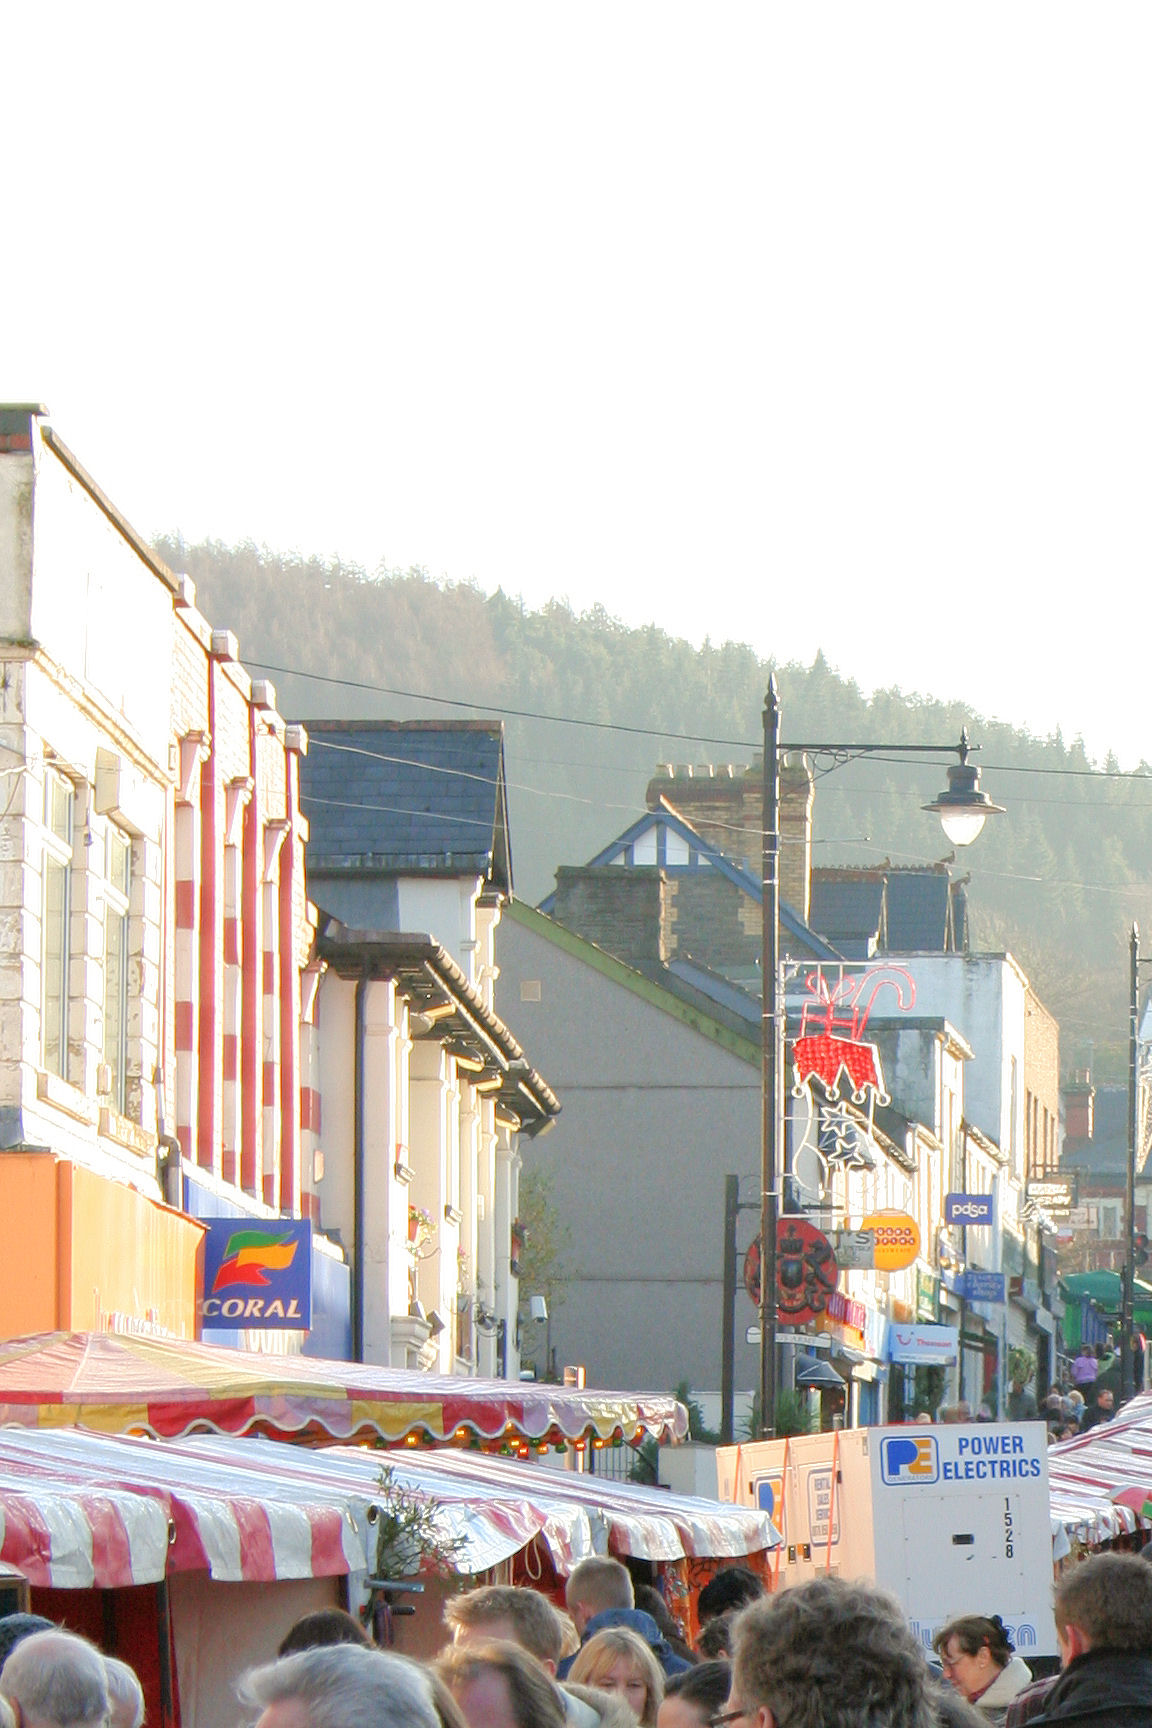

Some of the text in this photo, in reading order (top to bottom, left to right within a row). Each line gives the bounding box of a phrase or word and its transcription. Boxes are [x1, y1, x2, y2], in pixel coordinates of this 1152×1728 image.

[951, 1203, 988, 1218] pdsa
[203, 1298, 302, 1318] CORAL
[958, 1436, 1024, 1456] POWER
[943, 1458, 1041, 1480] ELECTRICS
